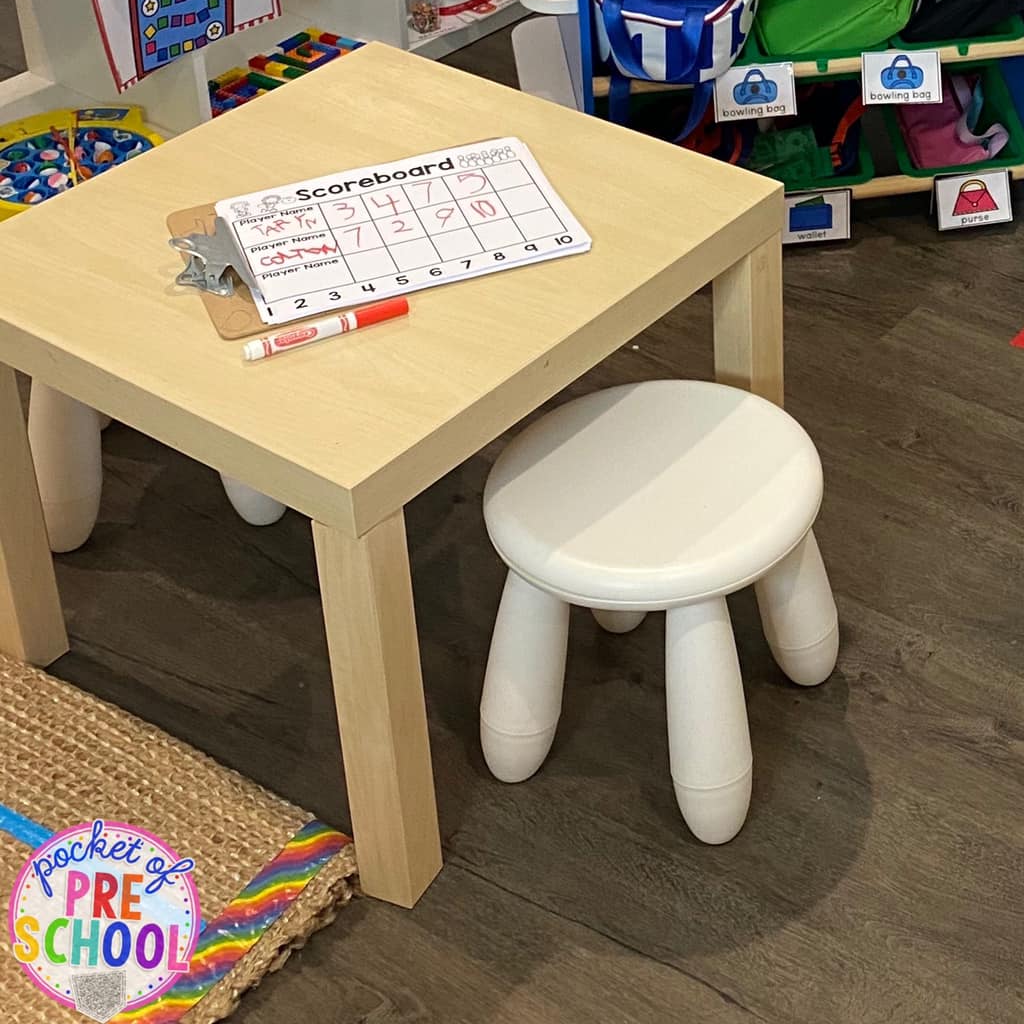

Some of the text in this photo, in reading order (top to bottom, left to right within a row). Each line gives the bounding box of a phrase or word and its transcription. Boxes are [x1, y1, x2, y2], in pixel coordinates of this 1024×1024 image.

[870, 90, 931, 101] bowling bag
[722, 103, 786, 118] bowling bag
[296, 157, 455, 201] Scoreboard
[332, 203, 356, 220] 3
[371, 194, 400, 216] 4
[412, 182, 432, 203] 7
[240, 206, 314, 226] Player Name
[343, 200, 496, 248] 7 2 9 10
[961, 214, 990, 224] purse
[251, 233, 326, 253] Player Name
[797, 230, 827, 240] wallet
[262, 259, 339, 280] Player Name
[294, 299, 309, 309] 2
[328, 292, 341, 301] 3
[361, 283, 376, 293] 4
[396, 275, 409, 285] 5
[429, 267, 442, 276] 6
[460, 260, 472, 270] 7
[493, 252, 506, 261] 8
[524, 244, 538, 252] 9
[555, 235, 573, 245] 10
